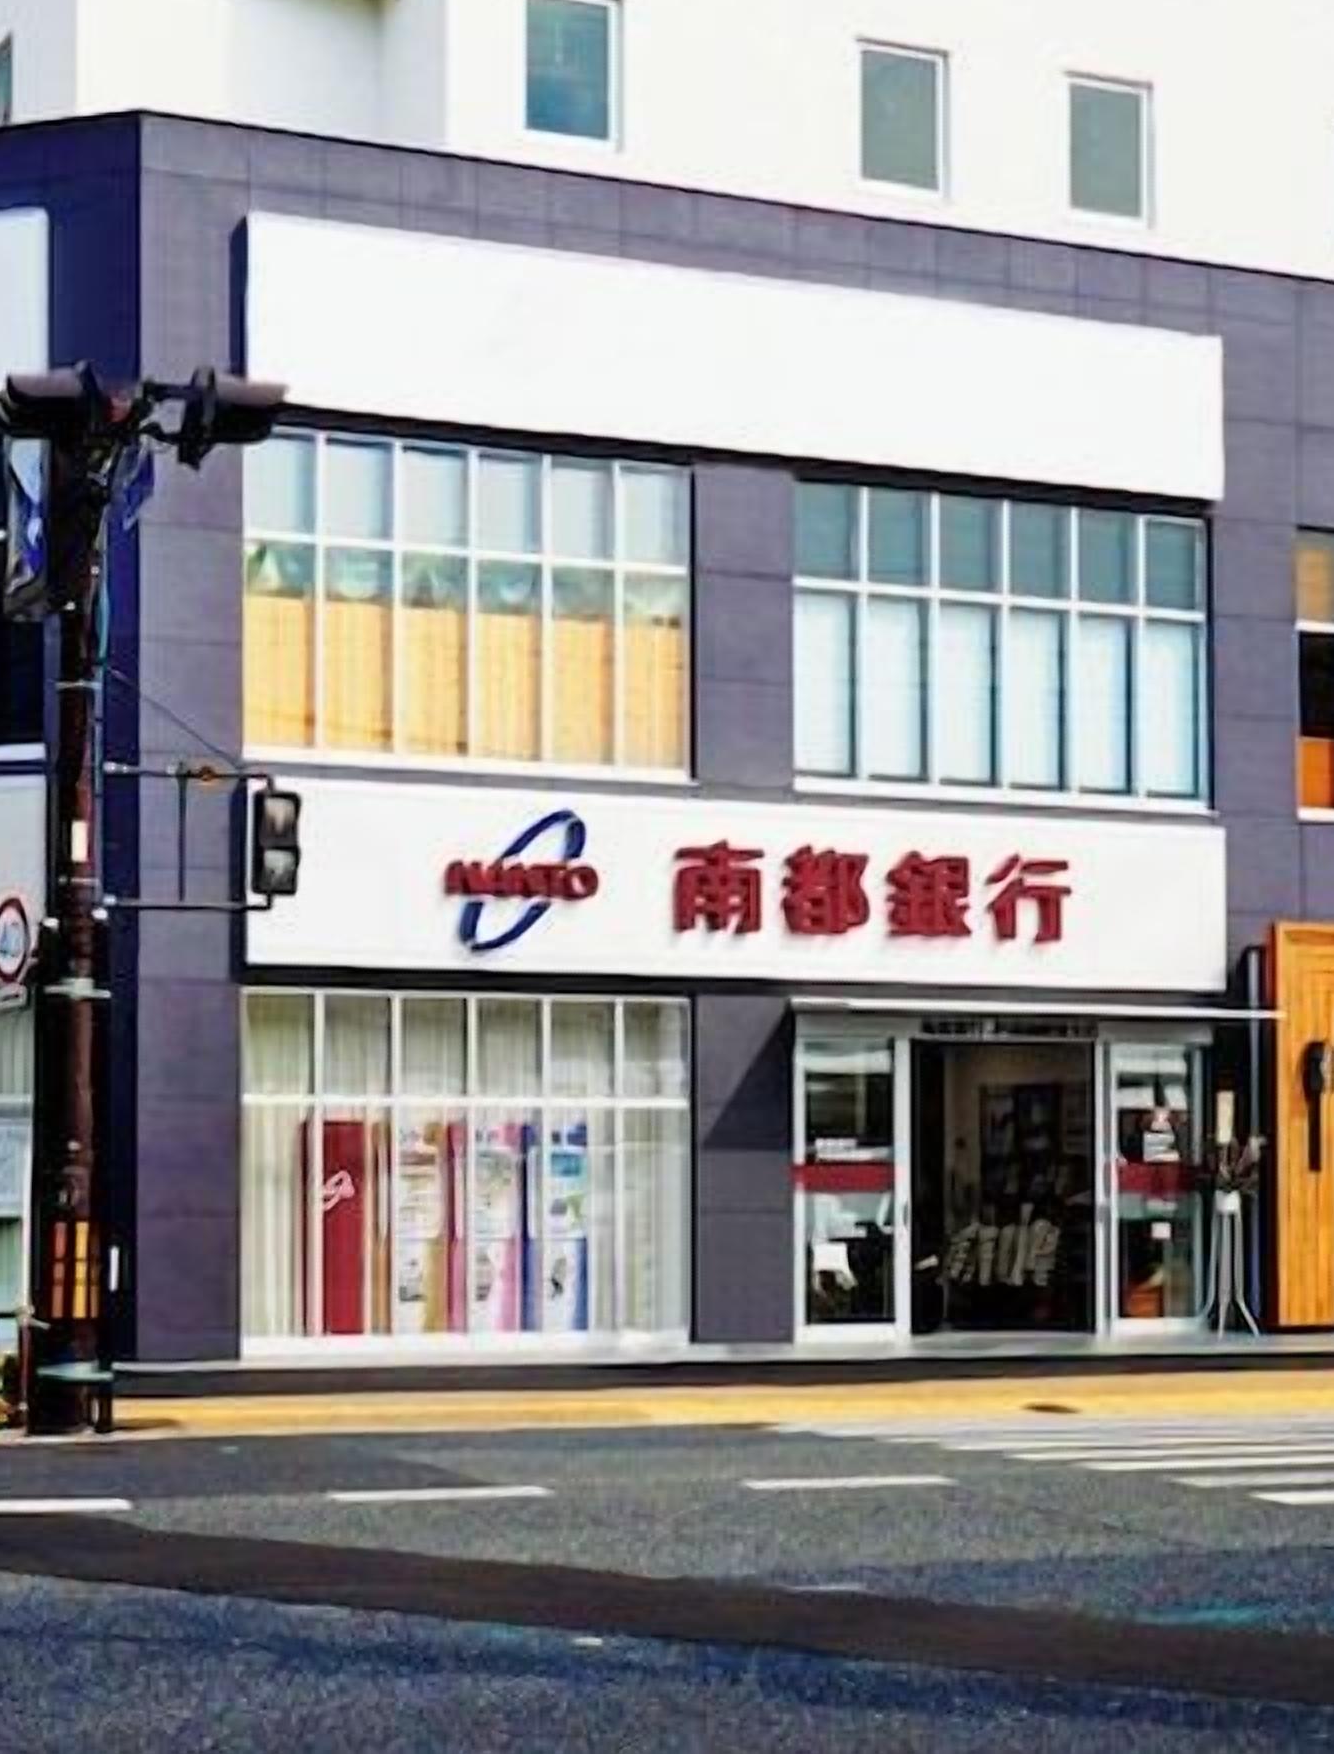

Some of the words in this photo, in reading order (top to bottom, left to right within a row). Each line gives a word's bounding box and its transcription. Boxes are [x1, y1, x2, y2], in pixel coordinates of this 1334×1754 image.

[443, 859, 599, 902] NANTO
[673, 839, 1073, 944] 南都銀行
